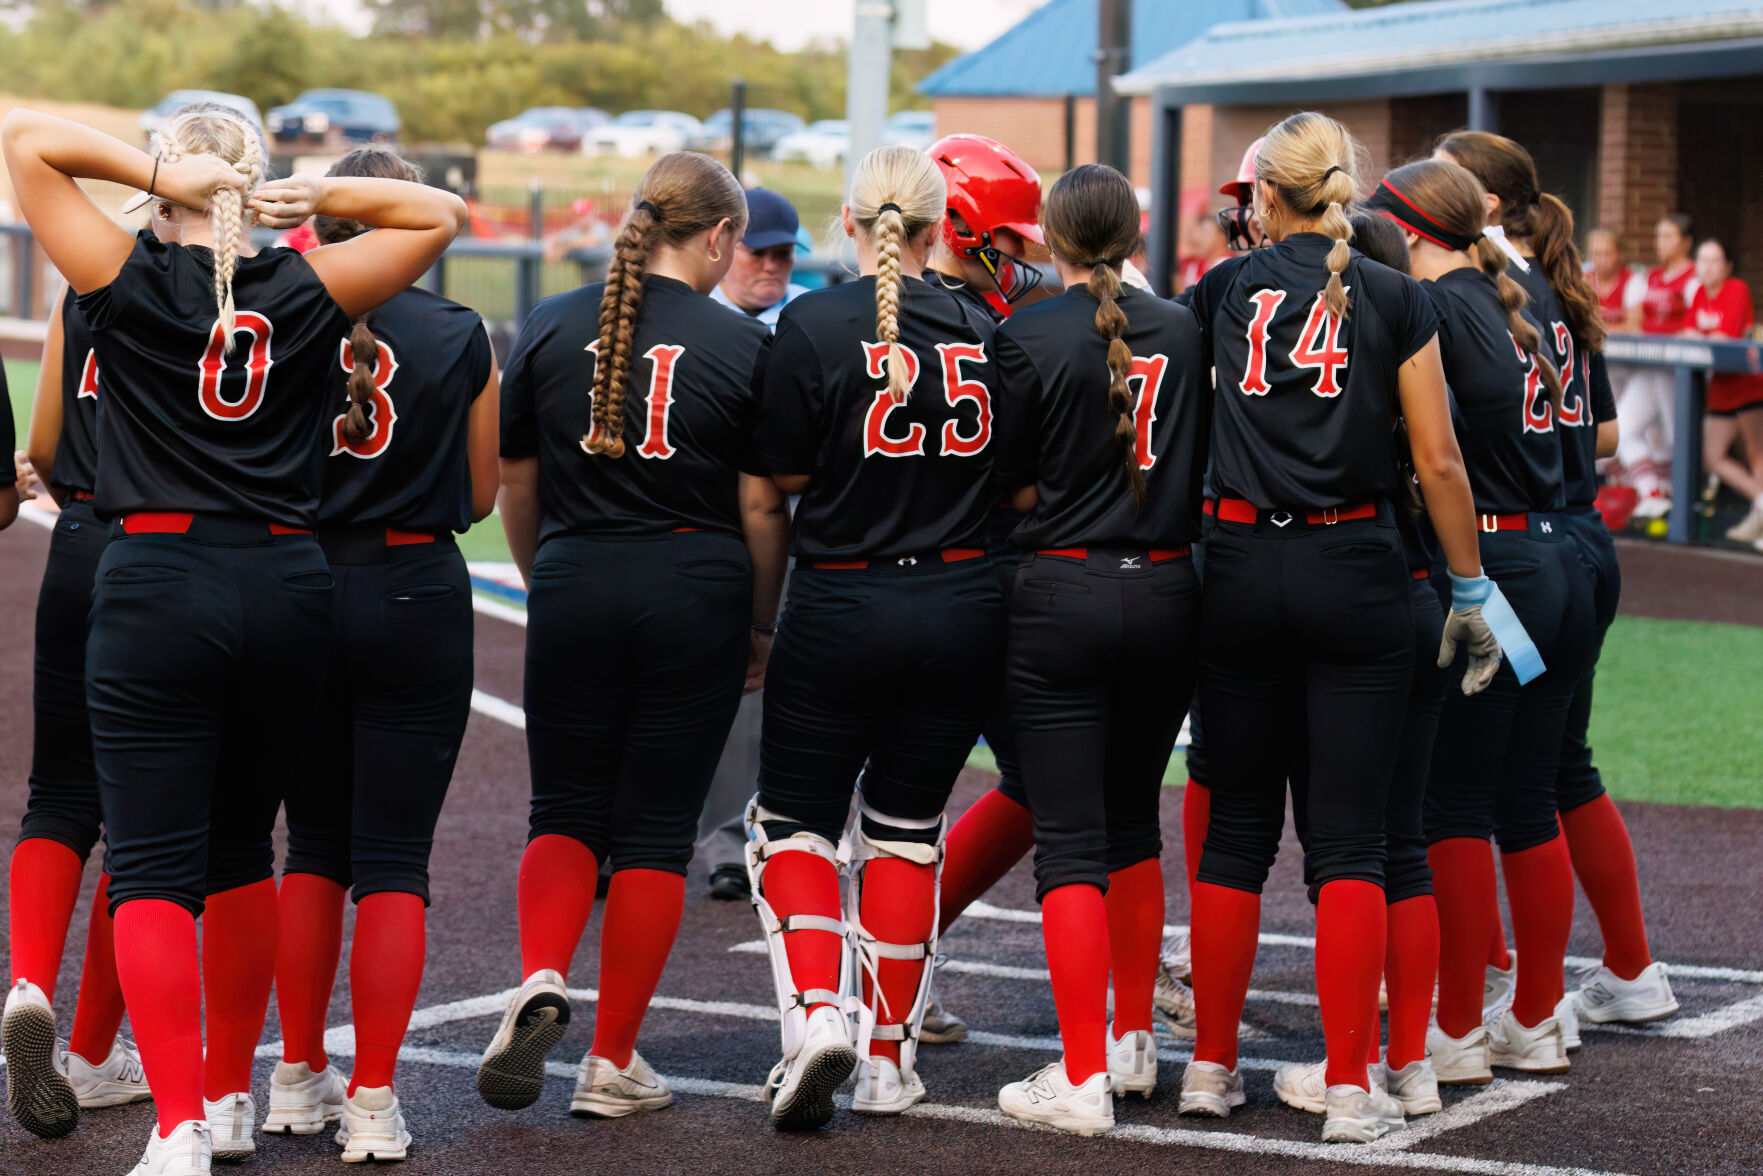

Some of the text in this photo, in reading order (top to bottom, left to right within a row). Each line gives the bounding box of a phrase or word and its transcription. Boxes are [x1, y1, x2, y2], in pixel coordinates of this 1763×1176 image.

[198, 311, 274, 421] 0
[329, 337, 399, 459] 3
[861, 340, 994, 458] 25
[1239, 286, 1351, 398] 14
[1107, 353, 1169, 470] 7
